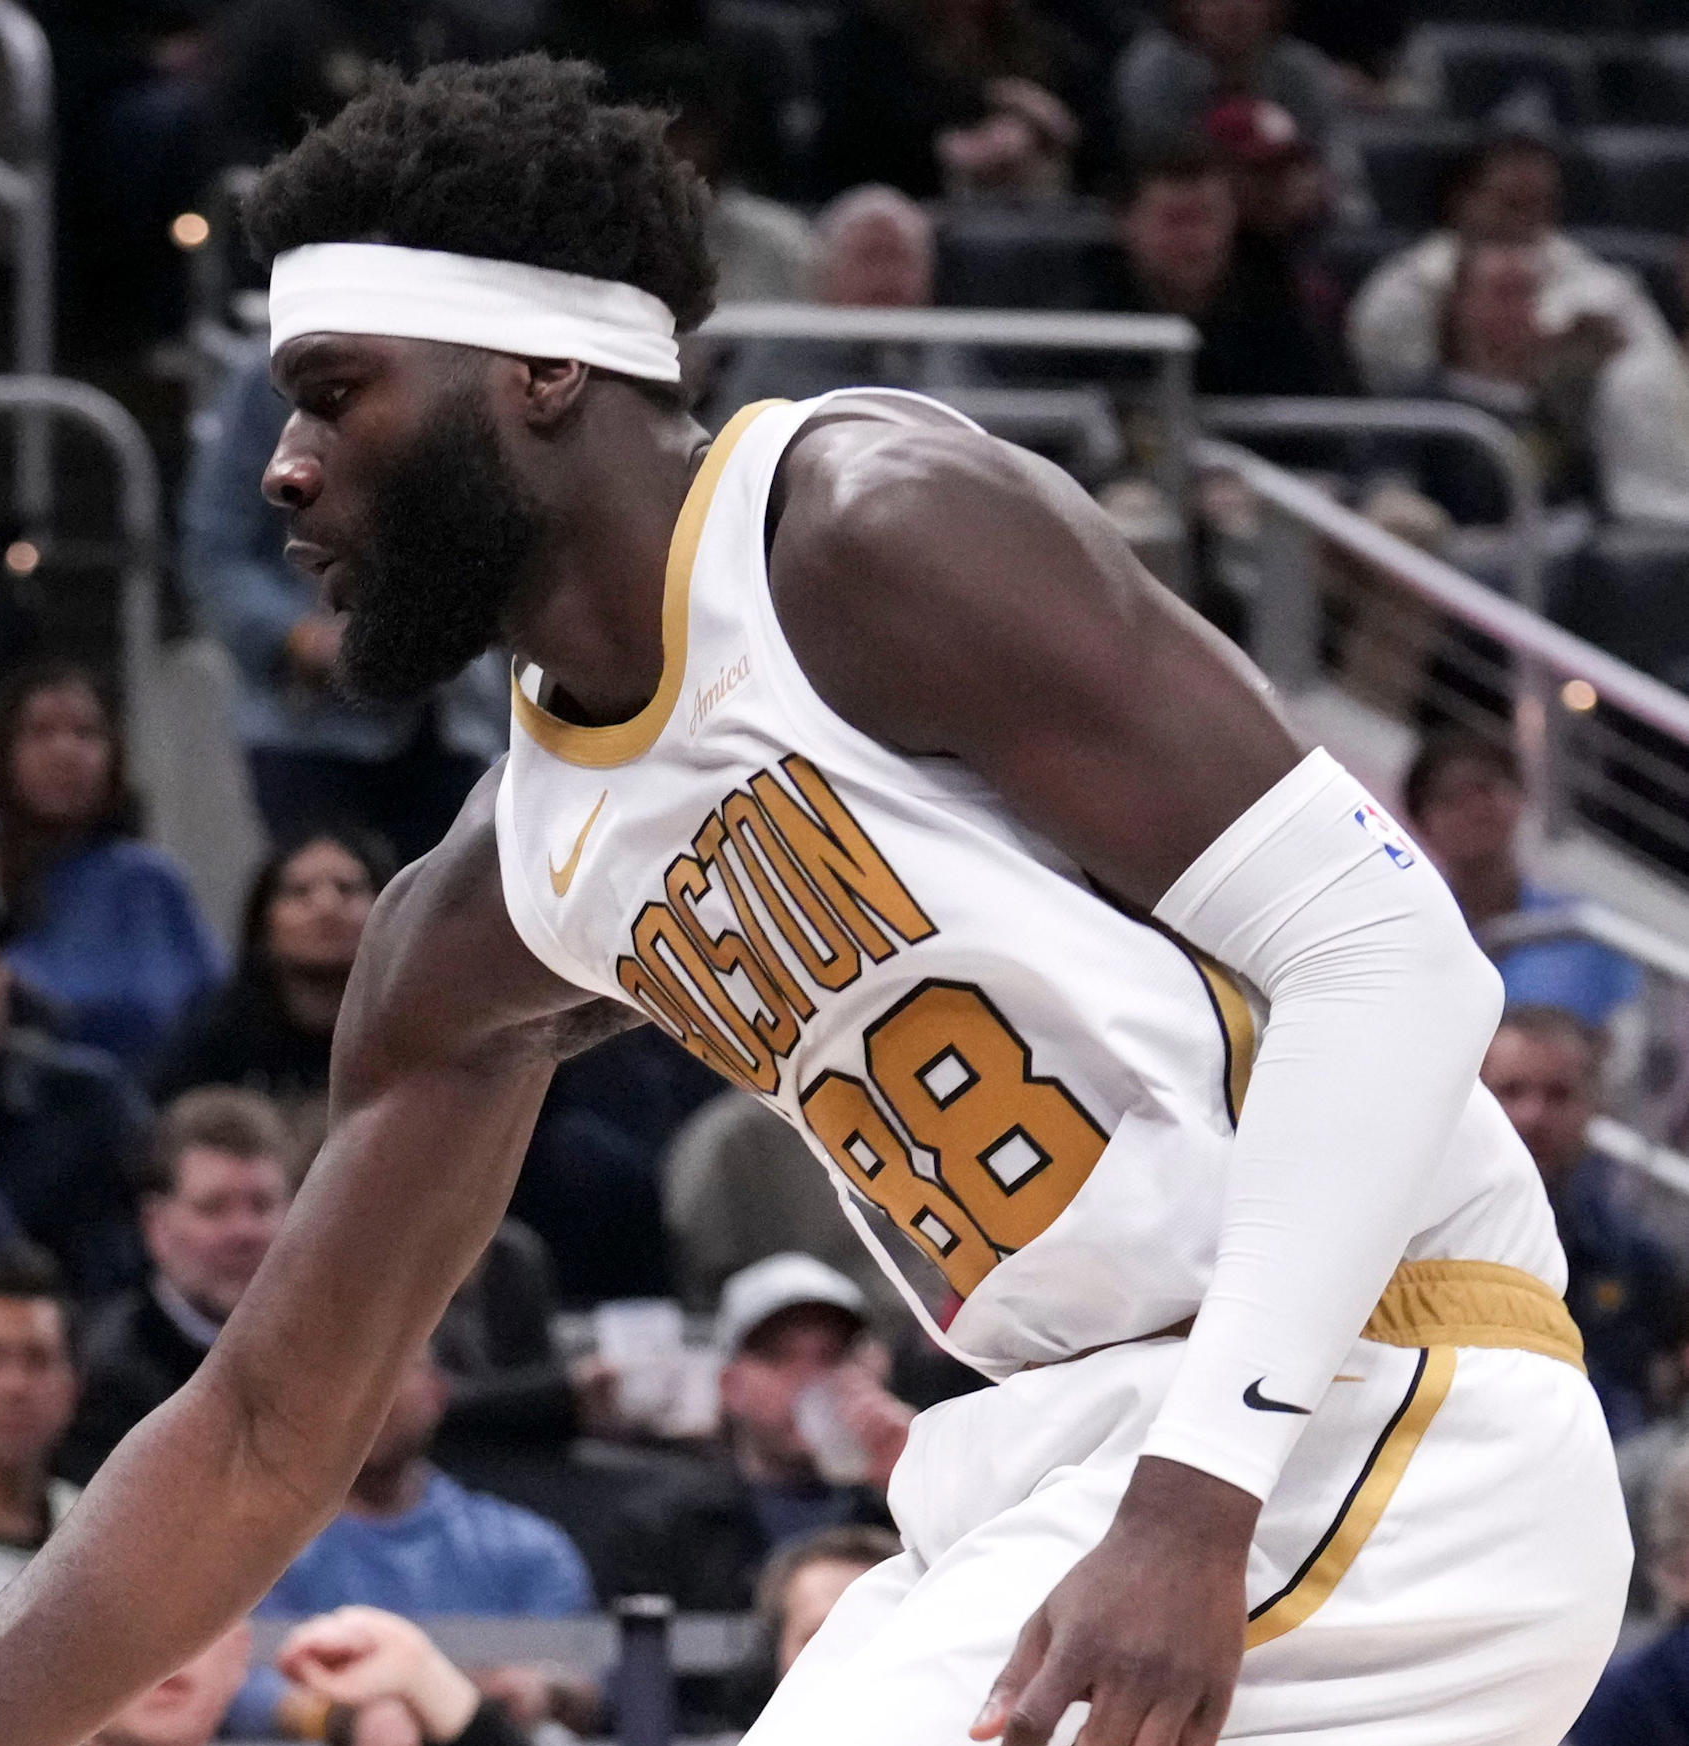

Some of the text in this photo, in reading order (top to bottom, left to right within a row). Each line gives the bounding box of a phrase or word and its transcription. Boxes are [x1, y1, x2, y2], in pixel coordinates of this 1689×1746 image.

[690, 655, 750, 737] Amica
[616, 752, 940, 1096] BOSTON
[799, 976, 1111, 1302] 88
